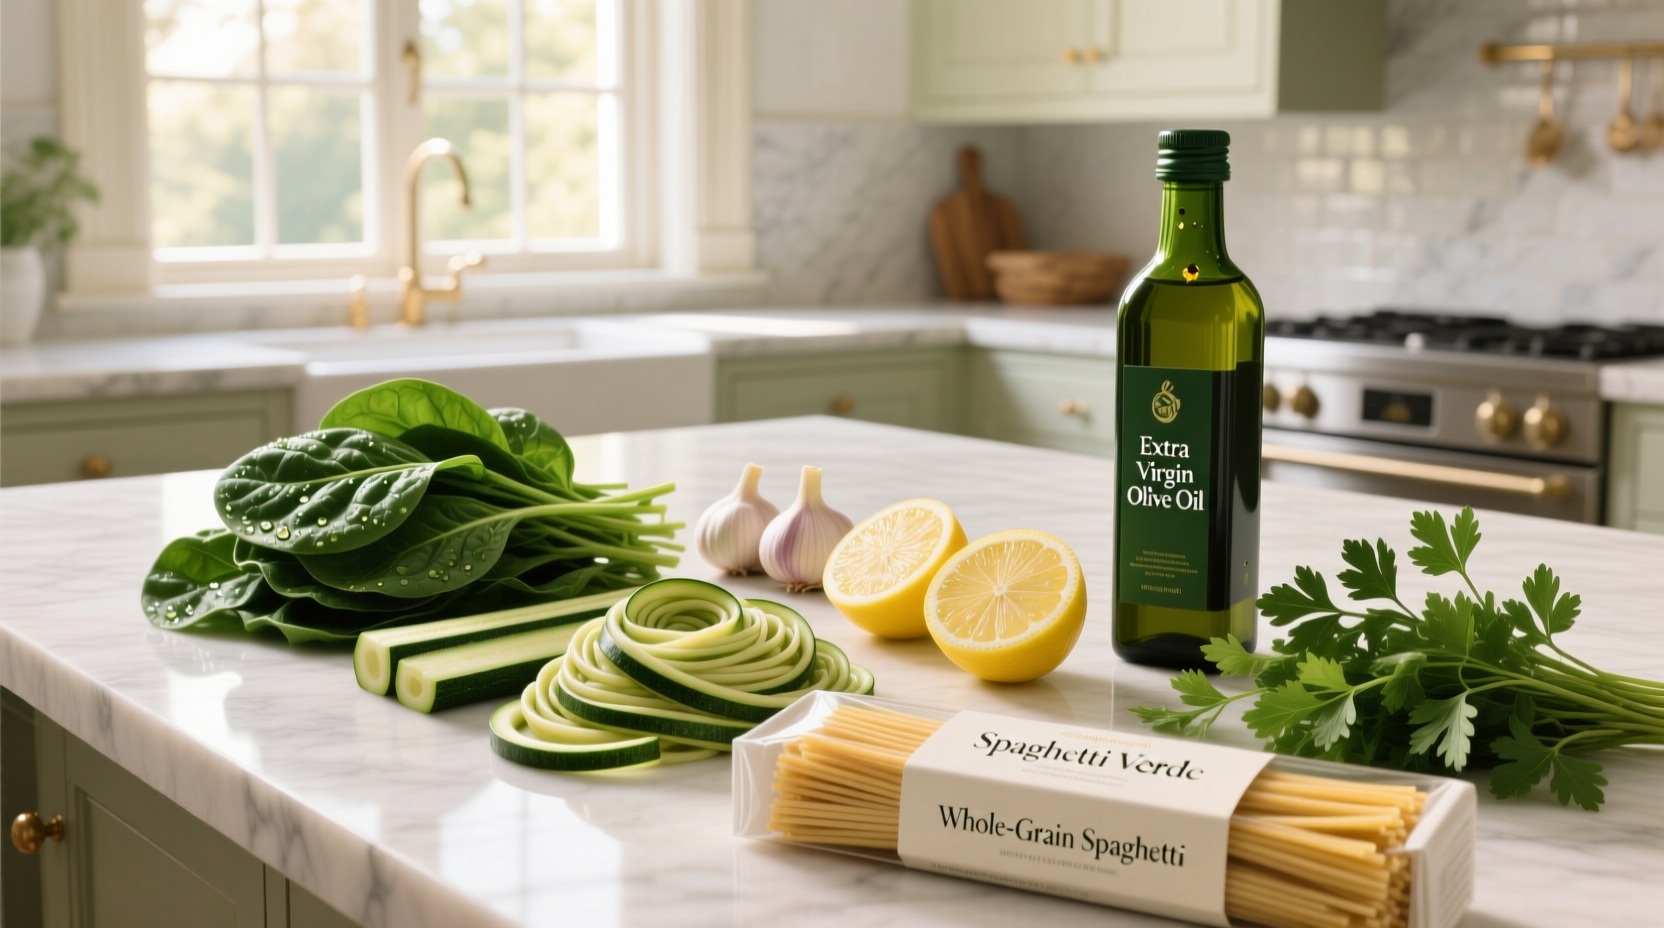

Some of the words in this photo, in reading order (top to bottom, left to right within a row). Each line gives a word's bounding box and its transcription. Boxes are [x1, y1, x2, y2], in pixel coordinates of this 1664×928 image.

[1140, 435, 1190, 458] Extra
[1136, 461, 1194, 489] Virgin
[1127, 485, 1172, 509] Olive
[1176, 489, 1204, 511] Oil
[973, 731, 1111, 768] Spaghetti
[938, 804, 1074, 849] Whole-Grain
[1081, 827, 1186, 868] Spaghetti
